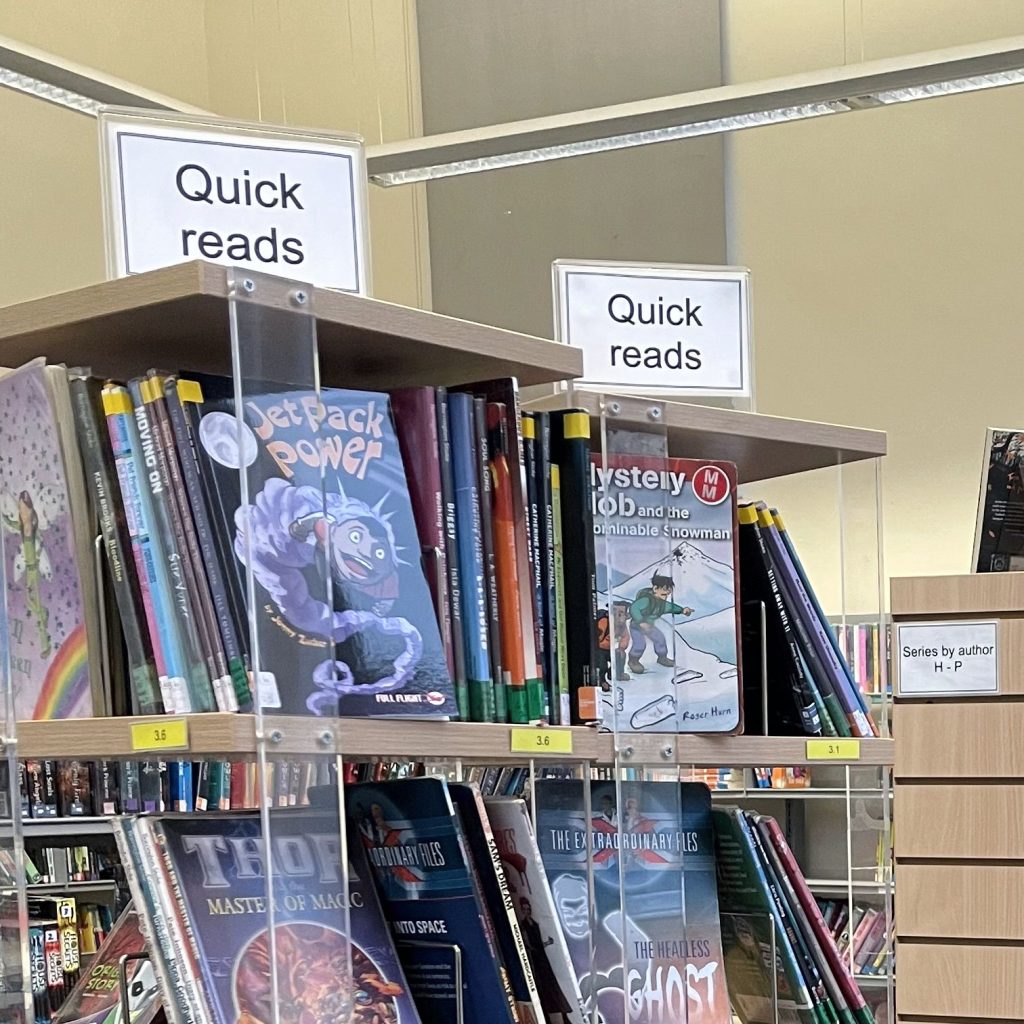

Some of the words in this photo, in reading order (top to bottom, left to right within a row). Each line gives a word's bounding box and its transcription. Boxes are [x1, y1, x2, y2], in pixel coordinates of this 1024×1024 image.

[176, 164, 304, 210] Quick
[182, 227, 304, 265] reads
[608, 293, 703, 327] Quick
[611, 341, 702, 370] reads
[132, 405, 158, 467] MOVING
[147, 470, 163, 494] ON
[591, 462, 686, 496] ystery
[703, 470, 719, 485] M
[592, 491, 635, 517] ob
[638, 506, 664, 518] and
[667, 506, 689, 519] the
[701, 486, 717, 500] M
[593, 523, 659, 537] ominable
[663, 525, 731, 540] Snowman
[452, 589, 462, 620] Dewar
[903, 646, 938, 658] Series
[942, 647, 955, 659] by
[958, 645, 994, 657] author
[934, 662, 943, 672] H
[954, 661, 963, 672] P
[536, 736, 550, 746] 3.6
[829, 745, 840, 754] 3.1
[550, 830, 571, 851] THE
[181, 834, 360, 888] THOR
[486, 838, 502, 871] SAM'S
[495, 872, 514, 911] DREAM
[208, 897, 280, 915] MASTER
[287, 895, 306, 911] OF
[312, 892, 364, 911] MAGIC
[417, 920, 447, 934] SPACE
[634, 941, 654, 959] THE
[657, 940, 710, 958] HEADLESS
[628, 962, 718, 1024] GHOST
